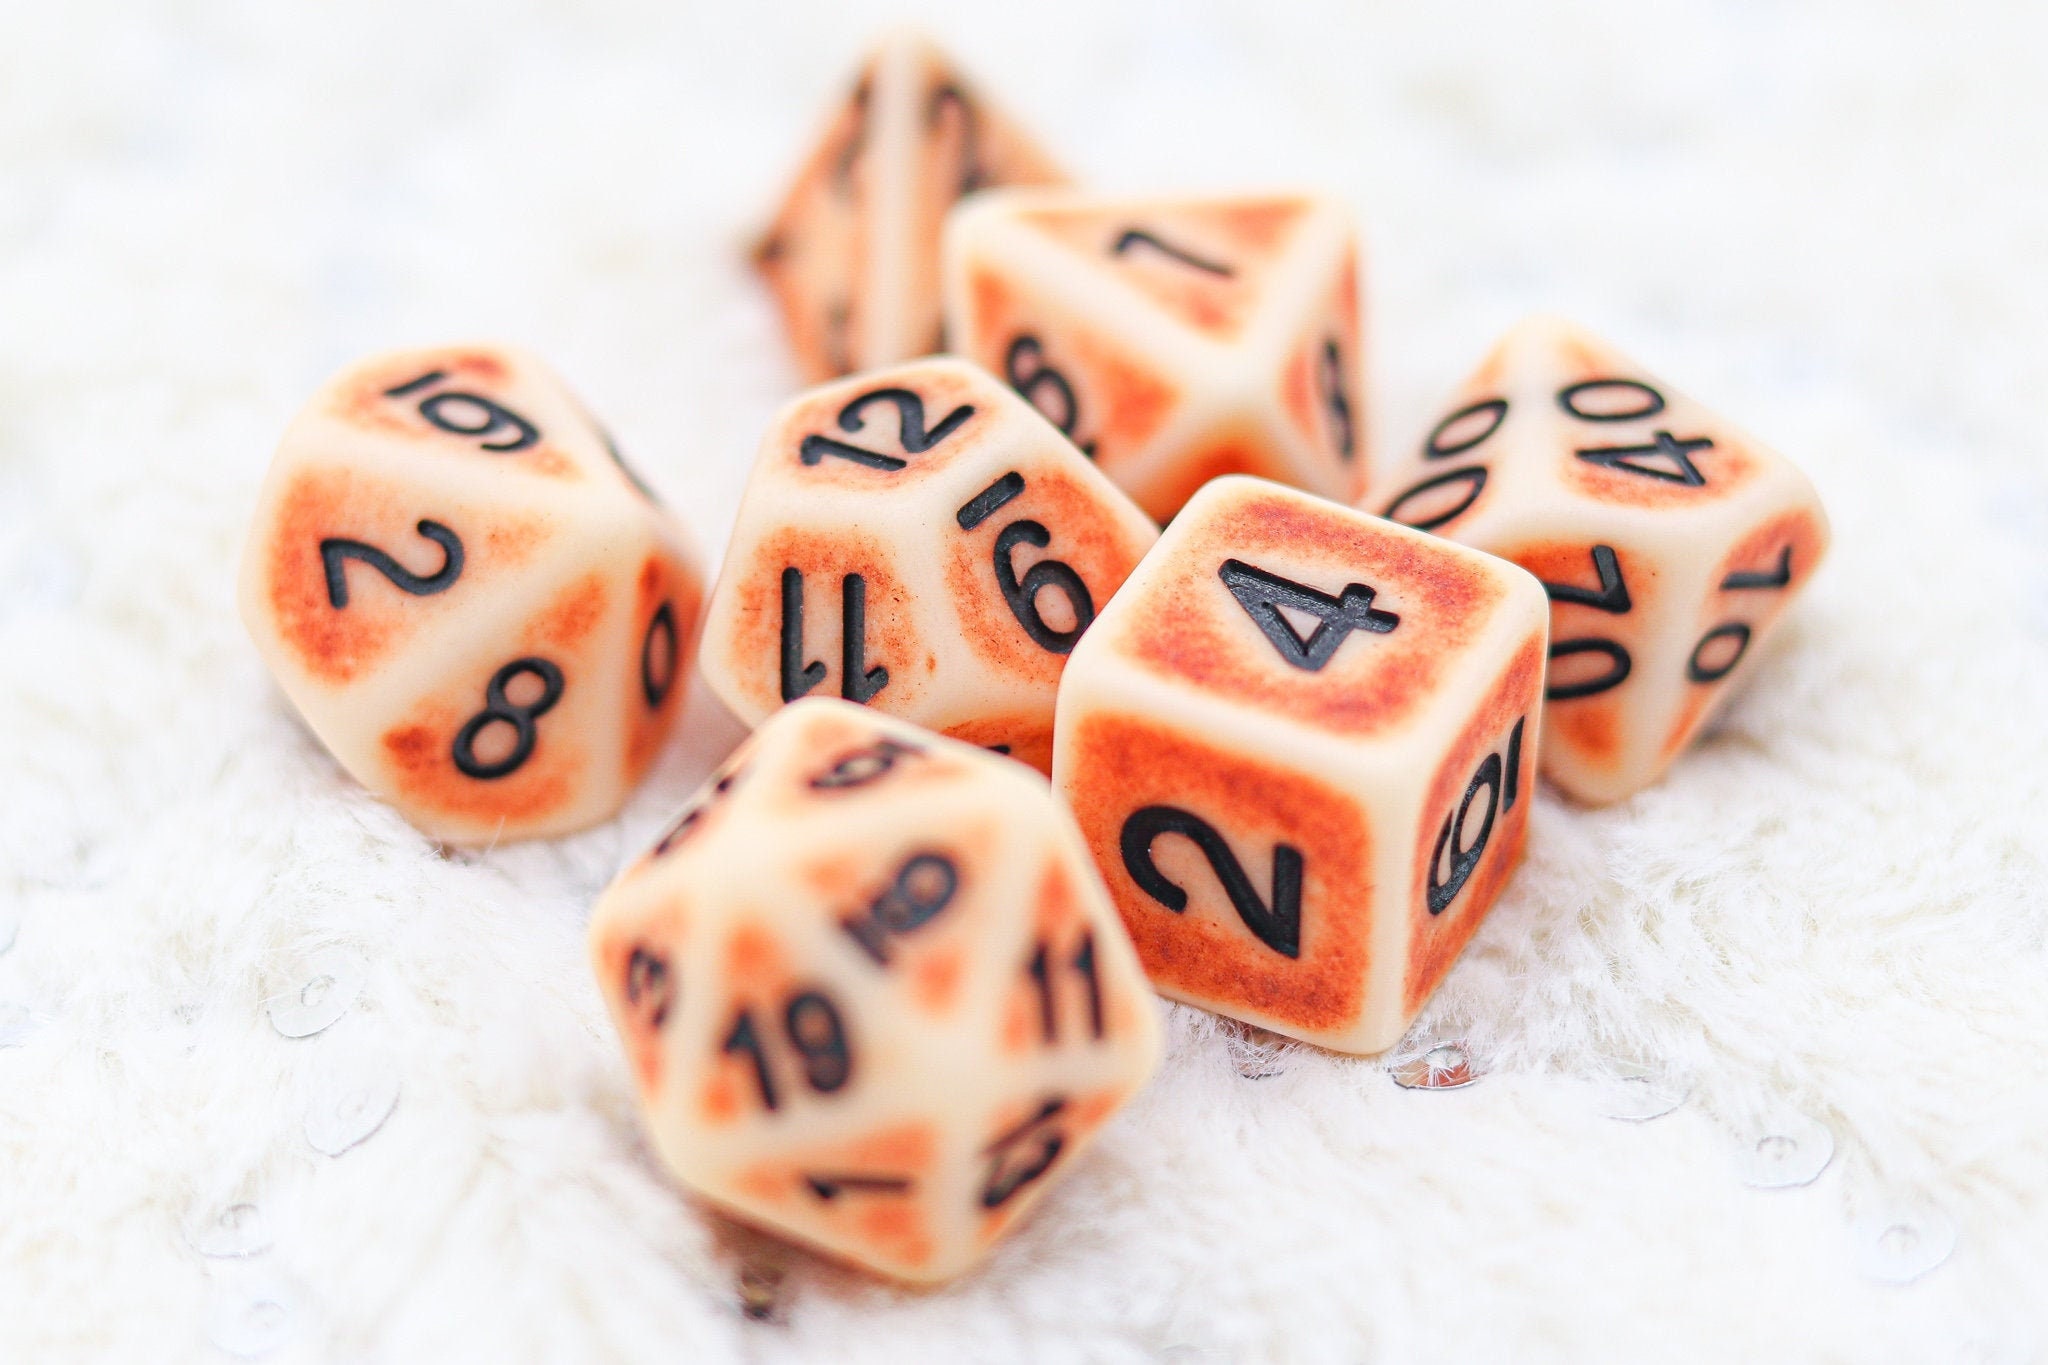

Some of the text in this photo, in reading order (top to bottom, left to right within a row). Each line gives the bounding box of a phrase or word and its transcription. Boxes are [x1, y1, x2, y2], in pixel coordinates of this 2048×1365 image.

[800, 388, 975, 471] 12
[1383, 399, 1508, 531] 00
[1559, 379, 1713, 487] 40
[320, 519, 465, 610] 2
[1219, 558, 1400, 672] 4
[1544, 545, 1631, 699] 70
[1688, 546, 1791, 683] 10
[781, 566, 889, 703] 11
[452, 657, 565, 780] 8
[1120, 805, 1305, 959] 2
[1028, 925, 1108, 1043] 11
[722, 990, 851, 1111] 19
